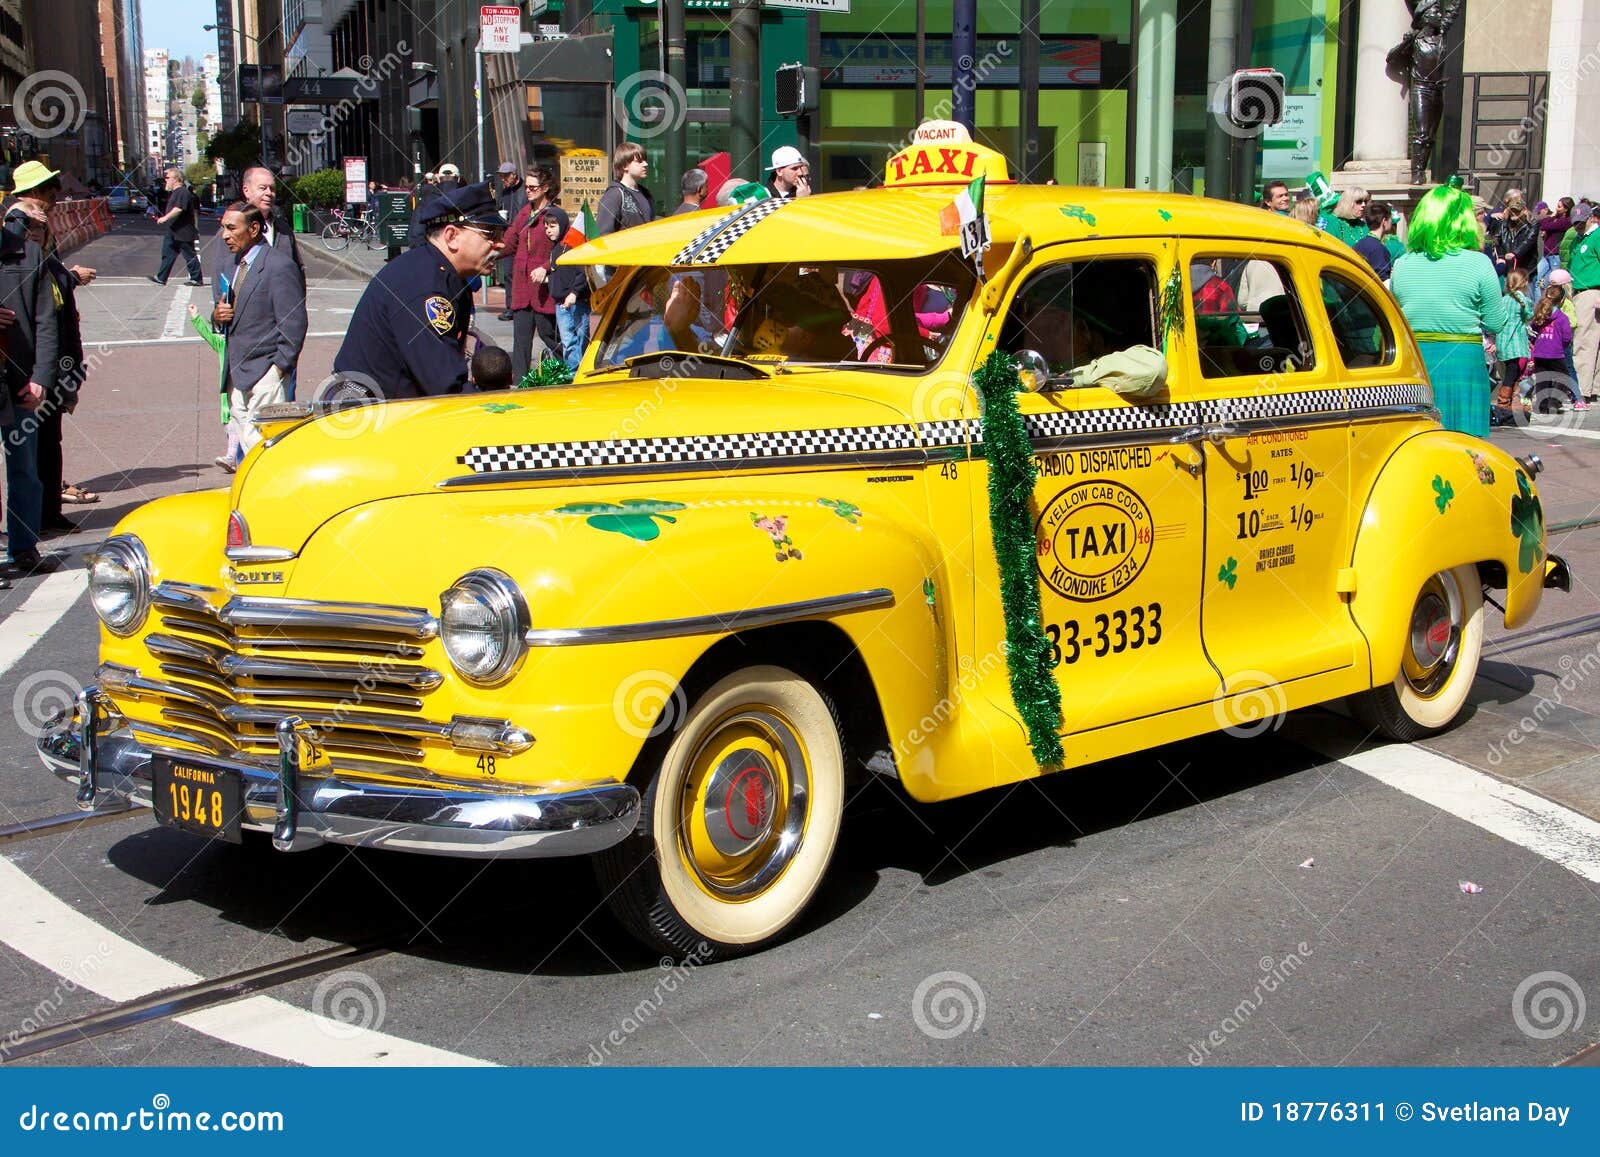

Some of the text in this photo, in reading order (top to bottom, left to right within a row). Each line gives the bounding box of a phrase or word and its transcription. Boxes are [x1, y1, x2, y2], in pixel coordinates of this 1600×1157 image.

[482, 15, 519, 25] NO STOPPING
[493, 35, 509, 43] TIME
[300, 79, 322, 95] 44
[917, 128, 956, 141] VACANT
[890, 148, 979, 181] TAXI
[1247, 430, 1309, 446] AIR CONDITIONED
[1033, 447, 1152, 477] RADIO DISPATCHED
[1271, 447, 1294, 459] RATES
[940, 462, 958, 480] 48
[1290, 461, 1314, 490] 1/9
[1047, 487, 1144, 527] YELLOW CAB COOP
[1290, 503, 1314, 531] 1/9
[1037, 522, 1151, 560] 19 TAXI 48
[1050, 556, 1138, 597] KLONDIKE 1234
[476, 753, 496, 774] 48
[174, 766, 215, 784] CALIFORNIA
[170, 783, 223, 828] 1948
